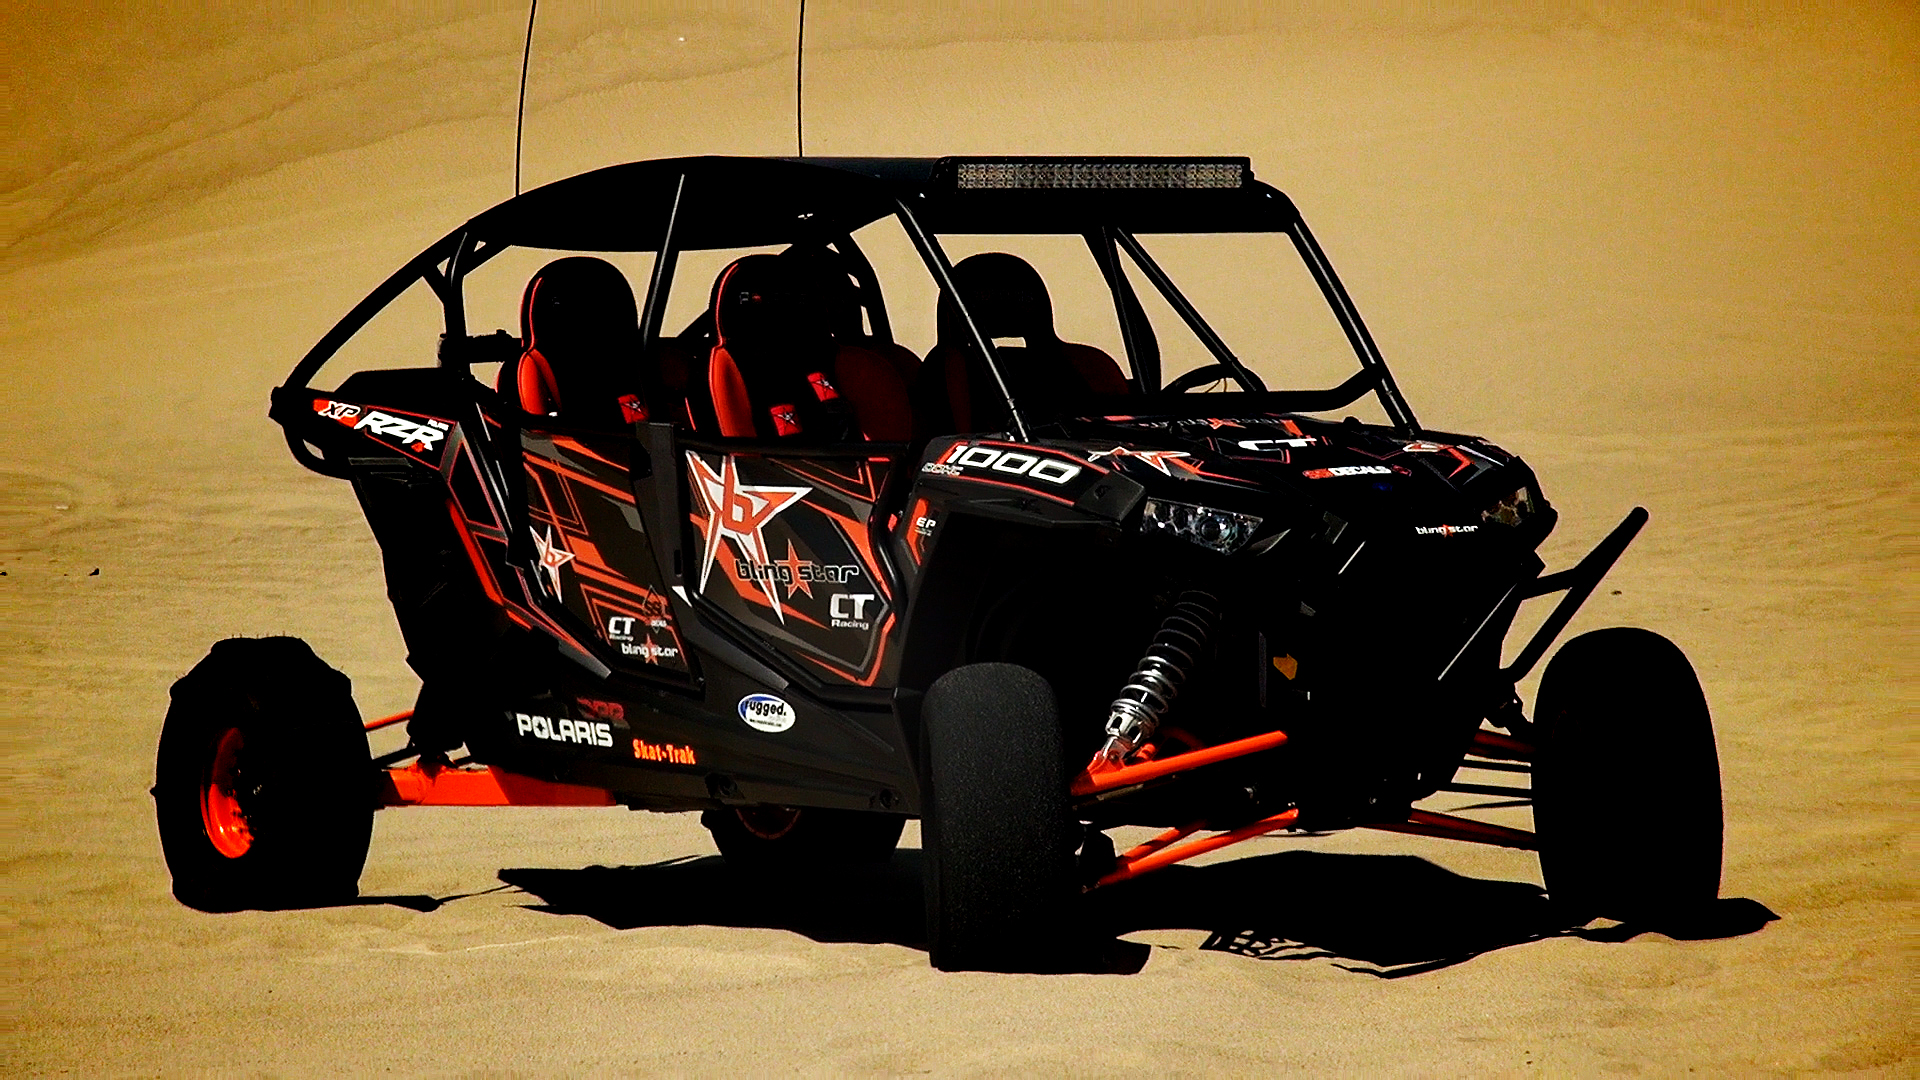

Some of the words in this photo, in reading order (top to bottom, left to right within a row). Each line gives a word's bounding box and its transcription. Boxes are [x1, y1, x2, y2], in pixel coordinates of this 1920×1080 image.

[318, 400, 362, 420] XP
[354, 411, 444, 451] RZR
[946, 446, 1082, 484] 1000
[916, 517, 937, 528] EP
[1415, 526, 1447, 536] bling
[1449, 525, 1478, 534] star
[734, 559, 792, 587] bling
[798, 563, 860, 584] star
[830, 593, 875, 619] CT
[608, 616, 636, 635] CT
[831, 619, 869, 630] Racing
[621, 642, 650, 659] bling
[650, 646, 678, 657] star
[515, 713, 613, 748] POLARIS
